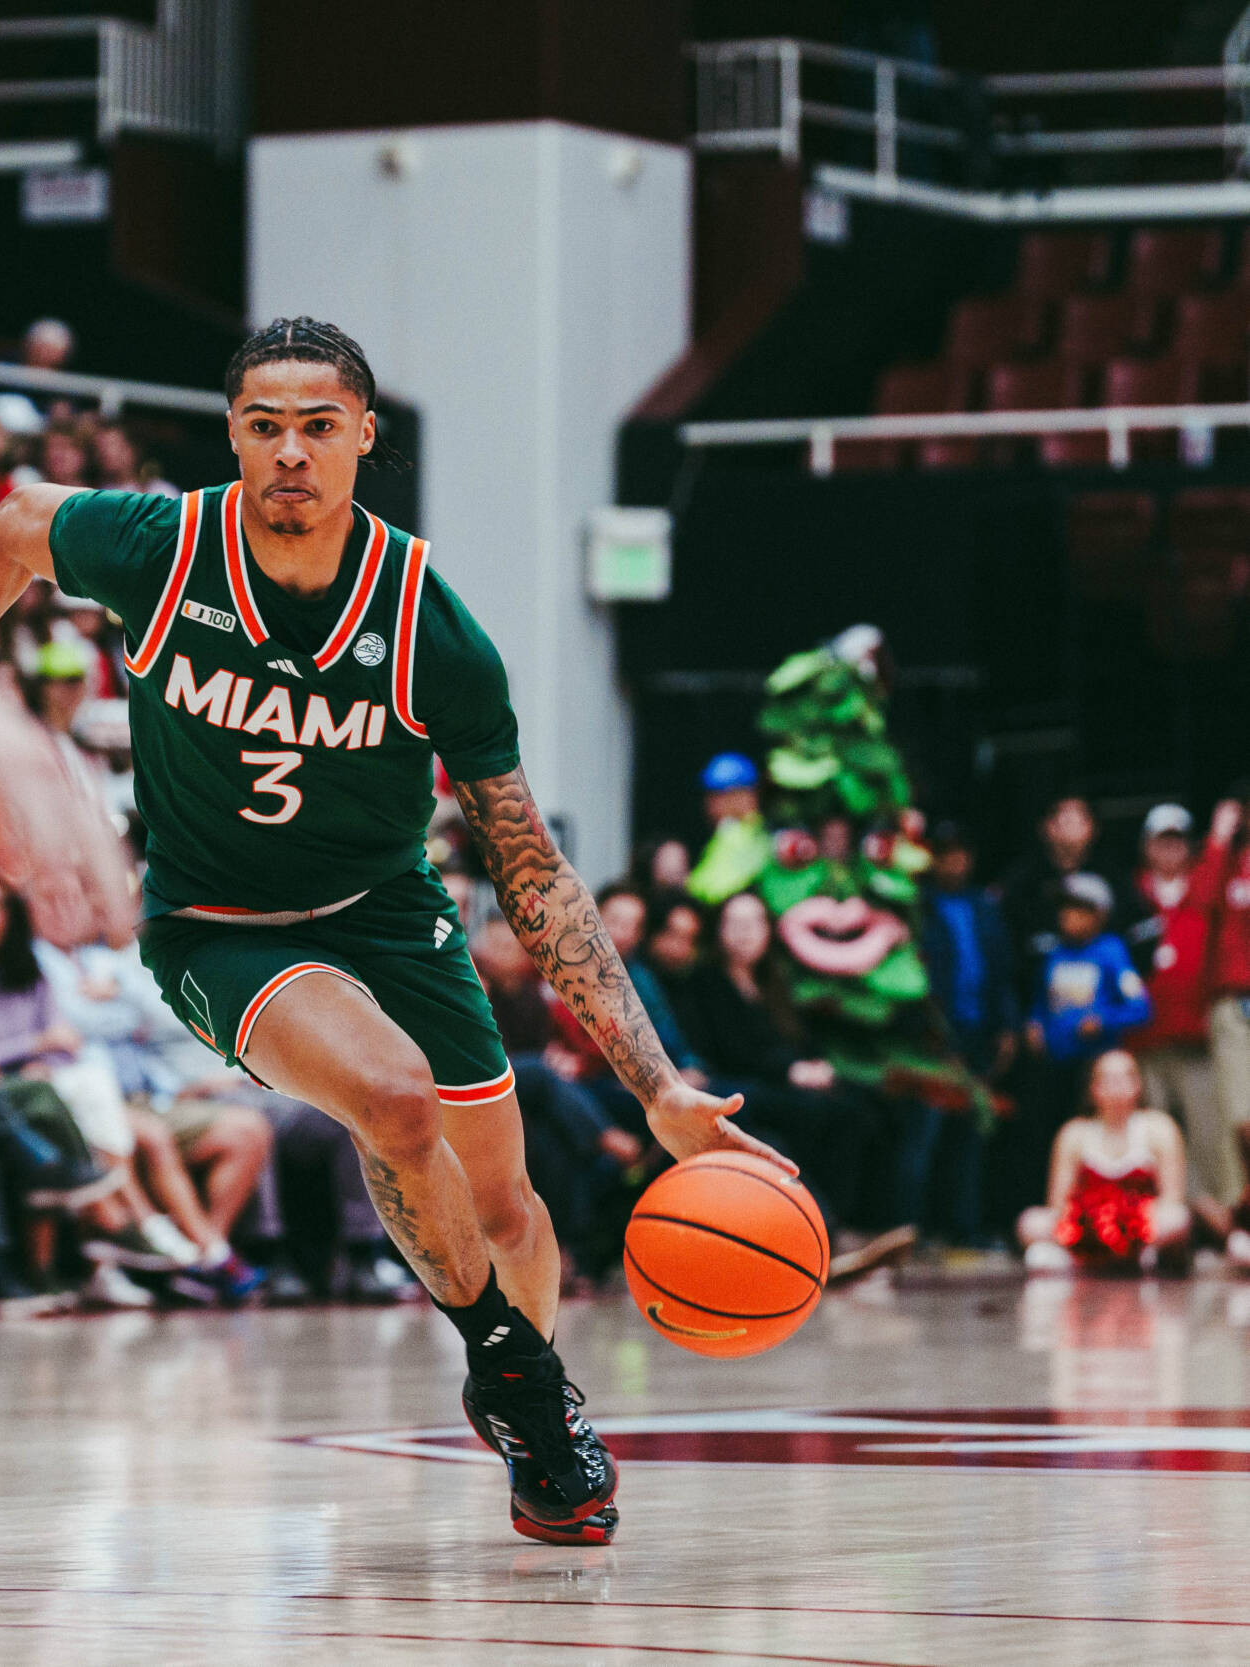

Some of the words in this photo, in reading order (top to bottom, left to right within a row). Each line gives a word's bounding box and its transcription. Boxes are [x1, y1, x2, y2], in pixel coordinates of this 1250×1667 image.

[208, 610, 233, 629] 100
[164, 653, 387, 750] MIAMI
[238, 749, 304, 824] 3
